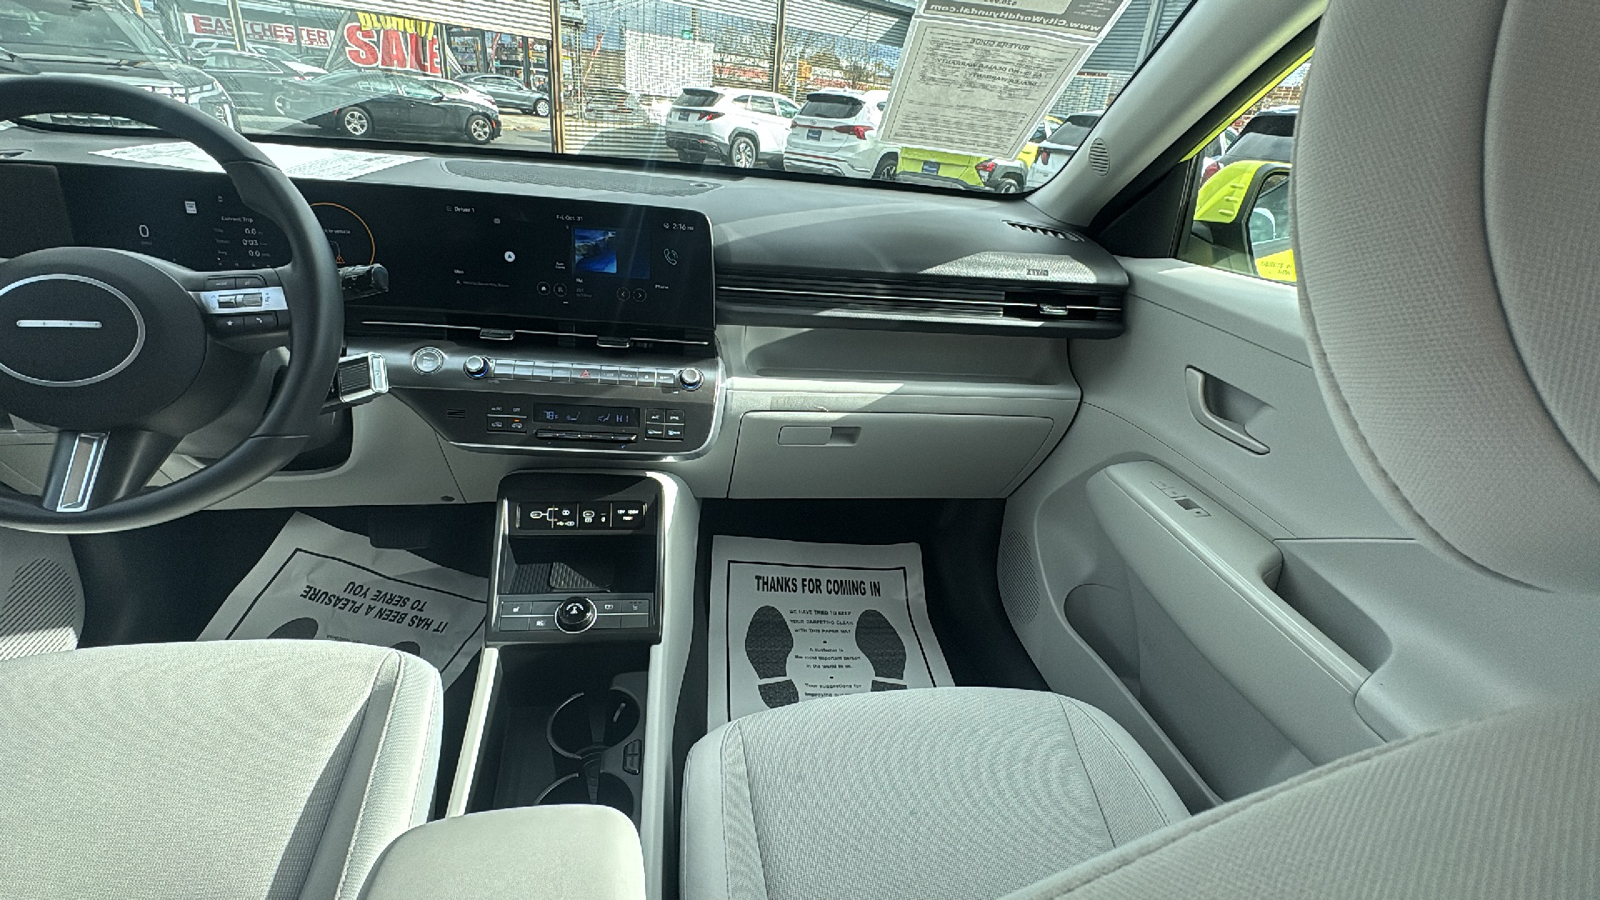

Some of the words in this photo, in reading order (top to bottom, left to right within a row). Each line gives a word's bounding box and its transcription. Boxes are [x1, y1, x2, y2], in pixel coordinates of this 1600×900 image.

[191, 14, 330, 46] EASTCHESTER
[345, 22, 442, 74] SALE
[343, 581, 370, 597] YOU
[754, 574, 798, 593] THANKS
[801, 577, 823, 594] FOR
[826, 578, 867, 596] COMING
[869, 580, 881, 597] IN
[299, 585, 364, 614] PLEASURE
[372, 589, 410, 607] SERVE
[412, 598, 428, 612] TO
[366, 604, 376, 616] A
[373, 607, 409, 625] BEEN
[408, 614, 434, 631] HAS
[433, 621, 449, 634] IT
